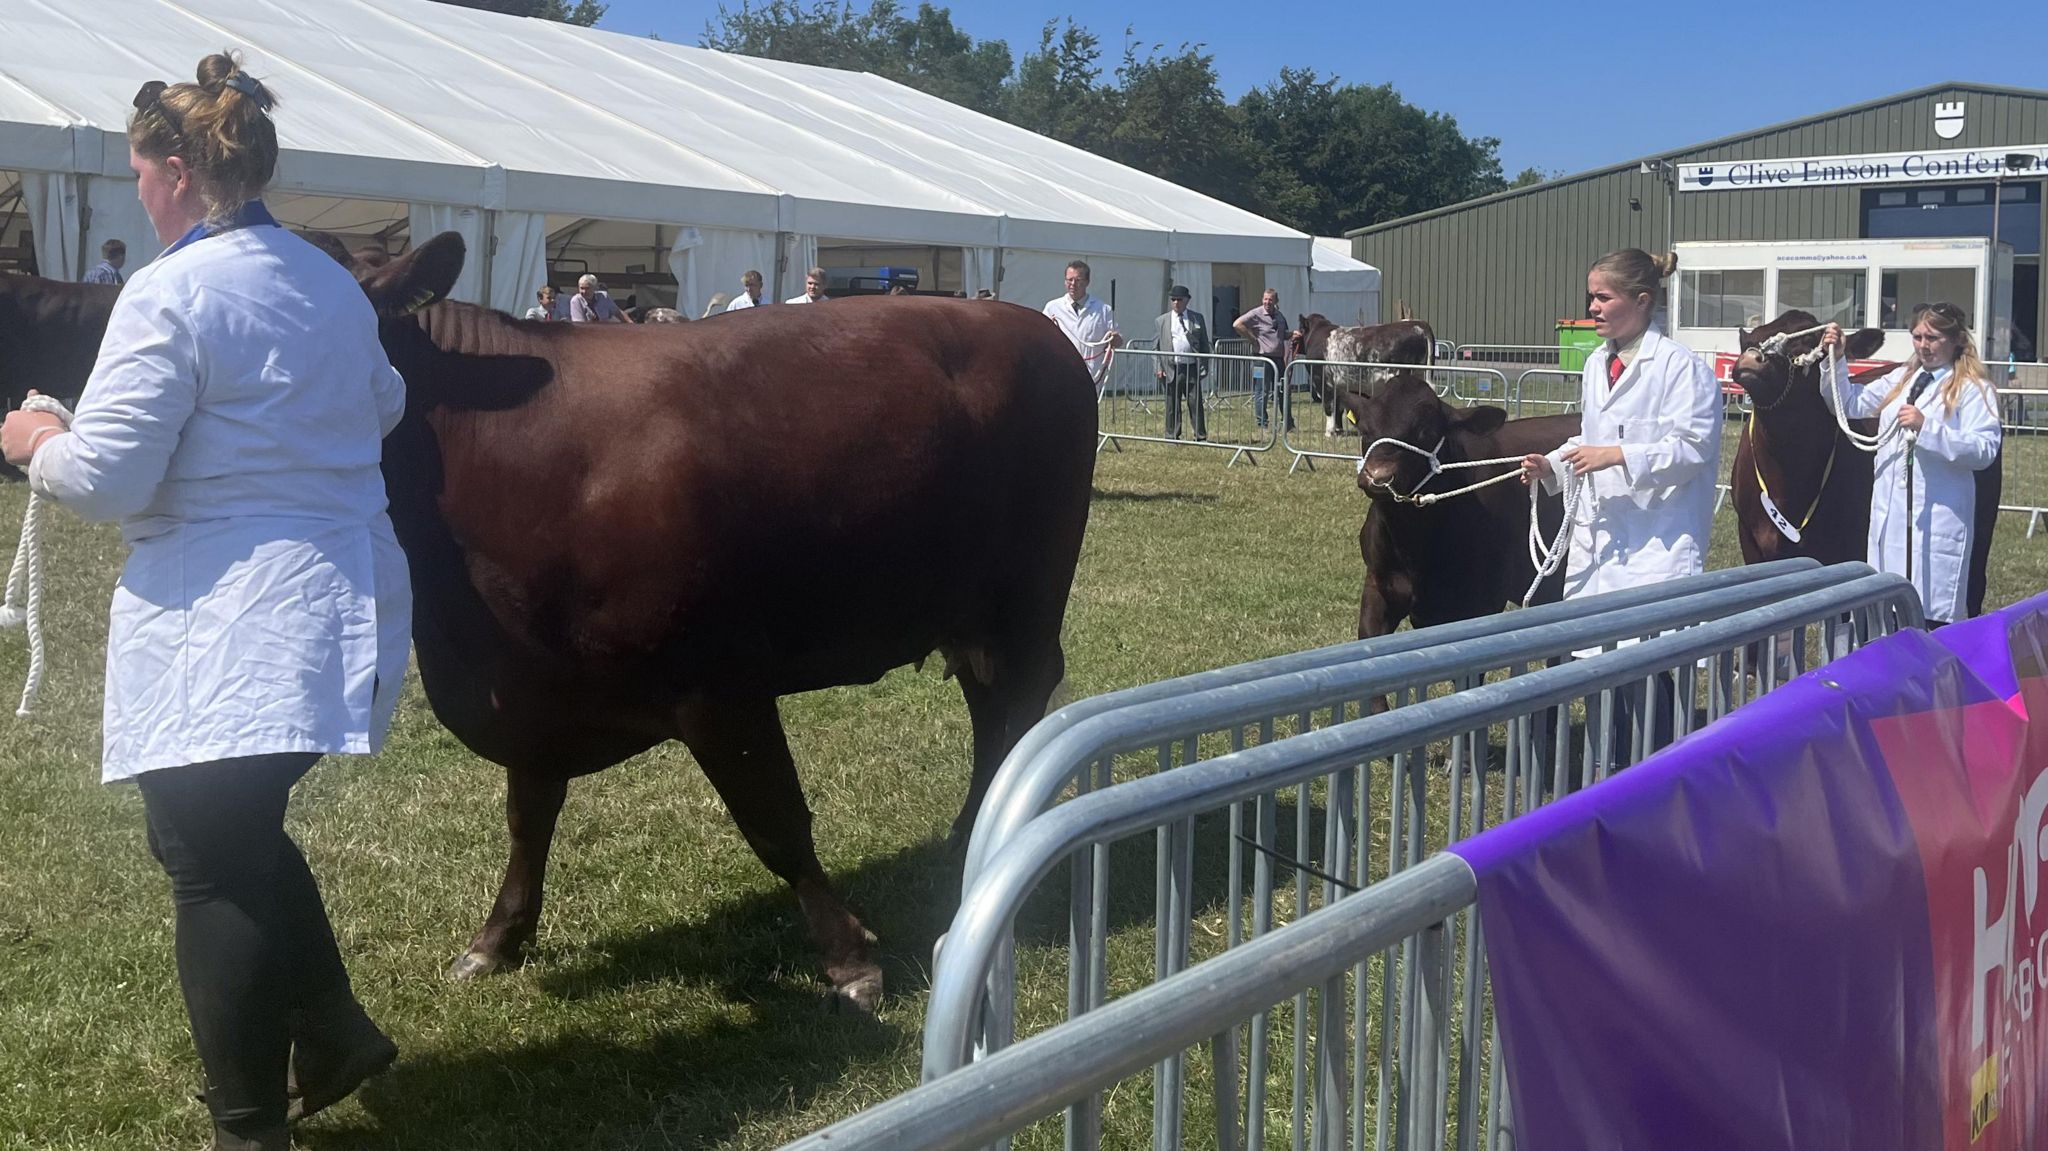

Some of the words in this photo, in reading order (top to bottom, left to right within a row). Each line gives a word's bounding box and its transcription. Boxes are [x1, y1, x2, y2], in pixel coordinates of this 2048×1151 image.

[1728, 162, 1792, 185] Clive
[1803, 160, 1890, 182] Emson
[1770, 508, 1787, 530] 42
